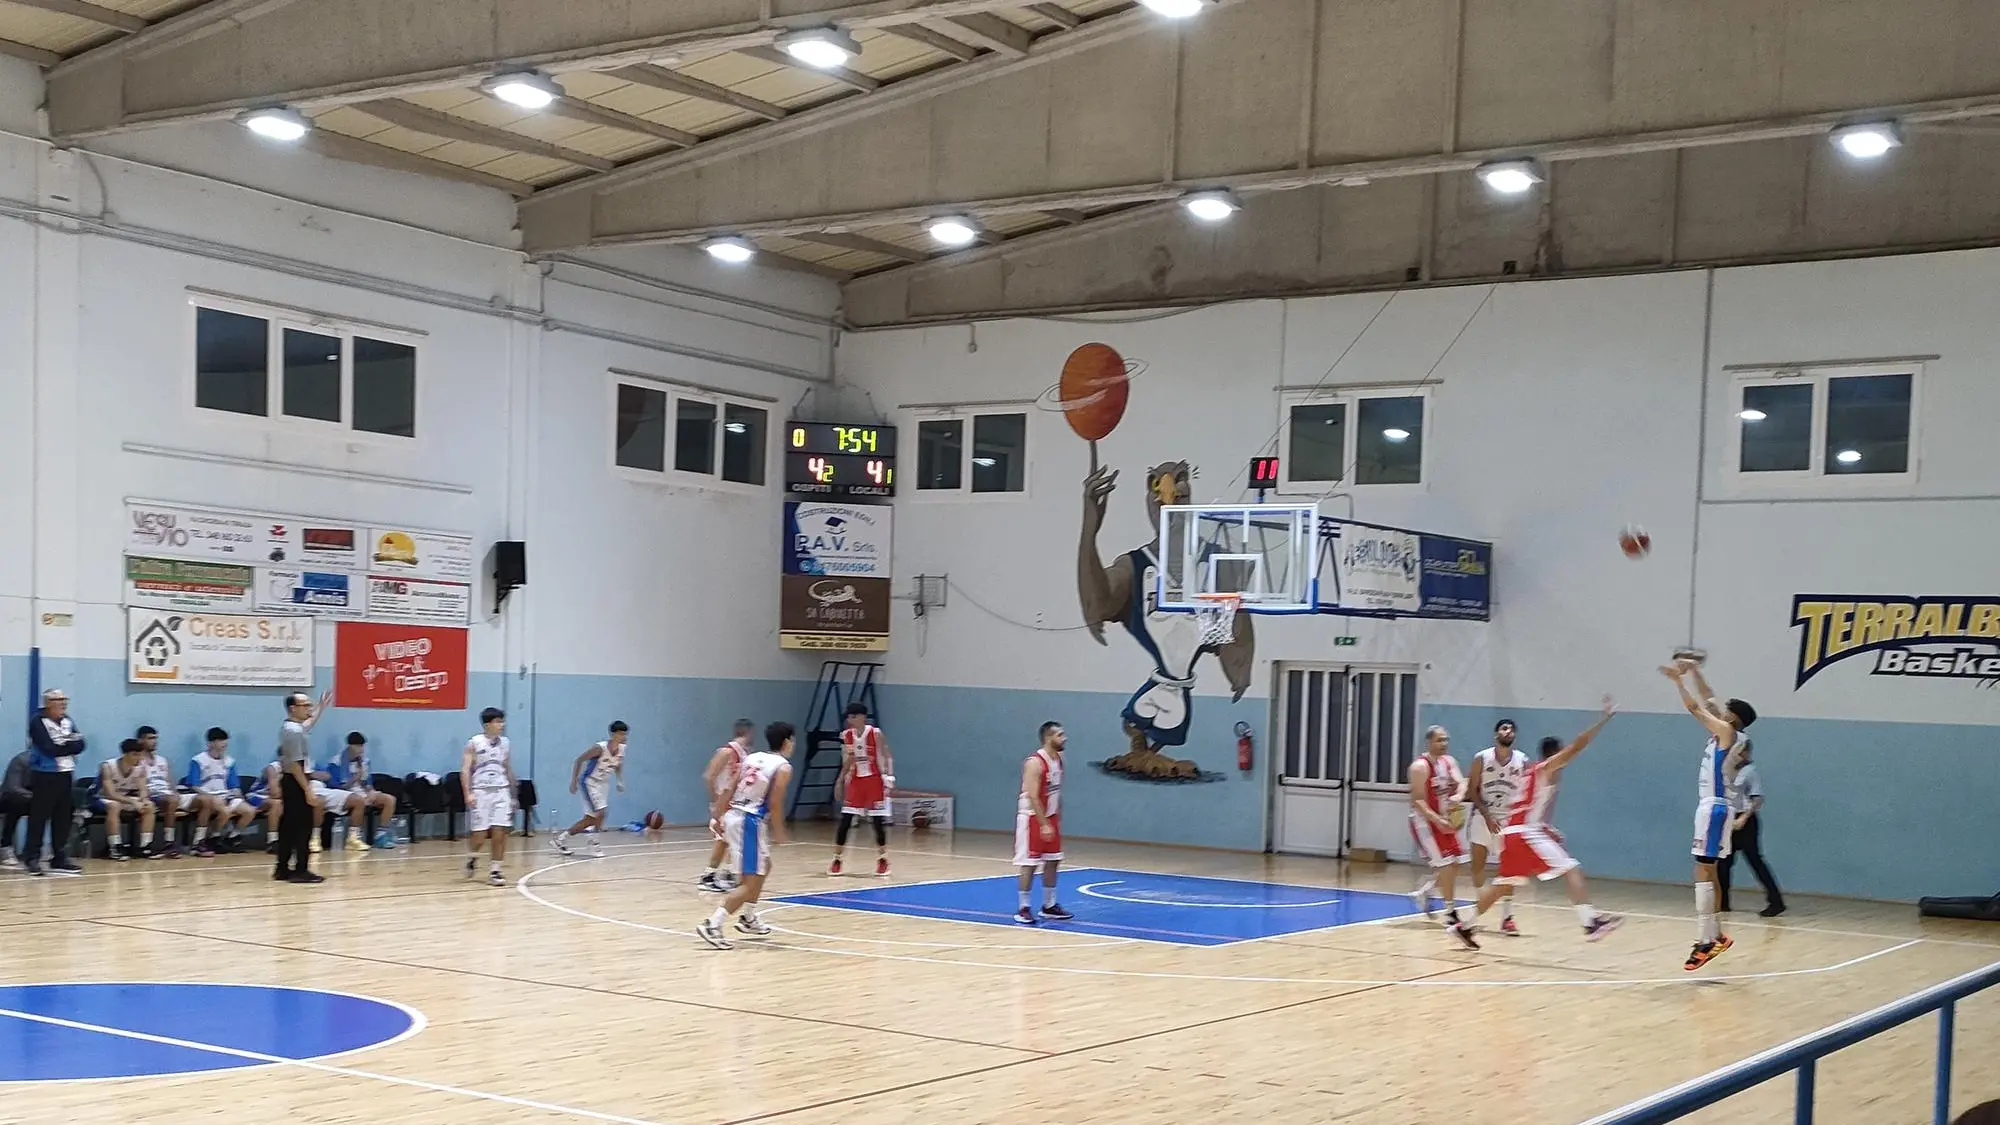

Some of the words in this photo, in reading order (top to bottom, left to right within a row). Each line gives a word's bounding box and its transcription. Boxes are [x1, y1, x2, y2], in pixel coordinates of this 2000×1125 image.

[792, 428, 805, 448] 0
[832, 427, 877, 453] 7:54
[791, 482, 832, 493] OSPITI
[848, 486, 890, 495] LOCALI
[188, 616, 250, 638] Creas
[373, 637, 433, 661] VIDEO
